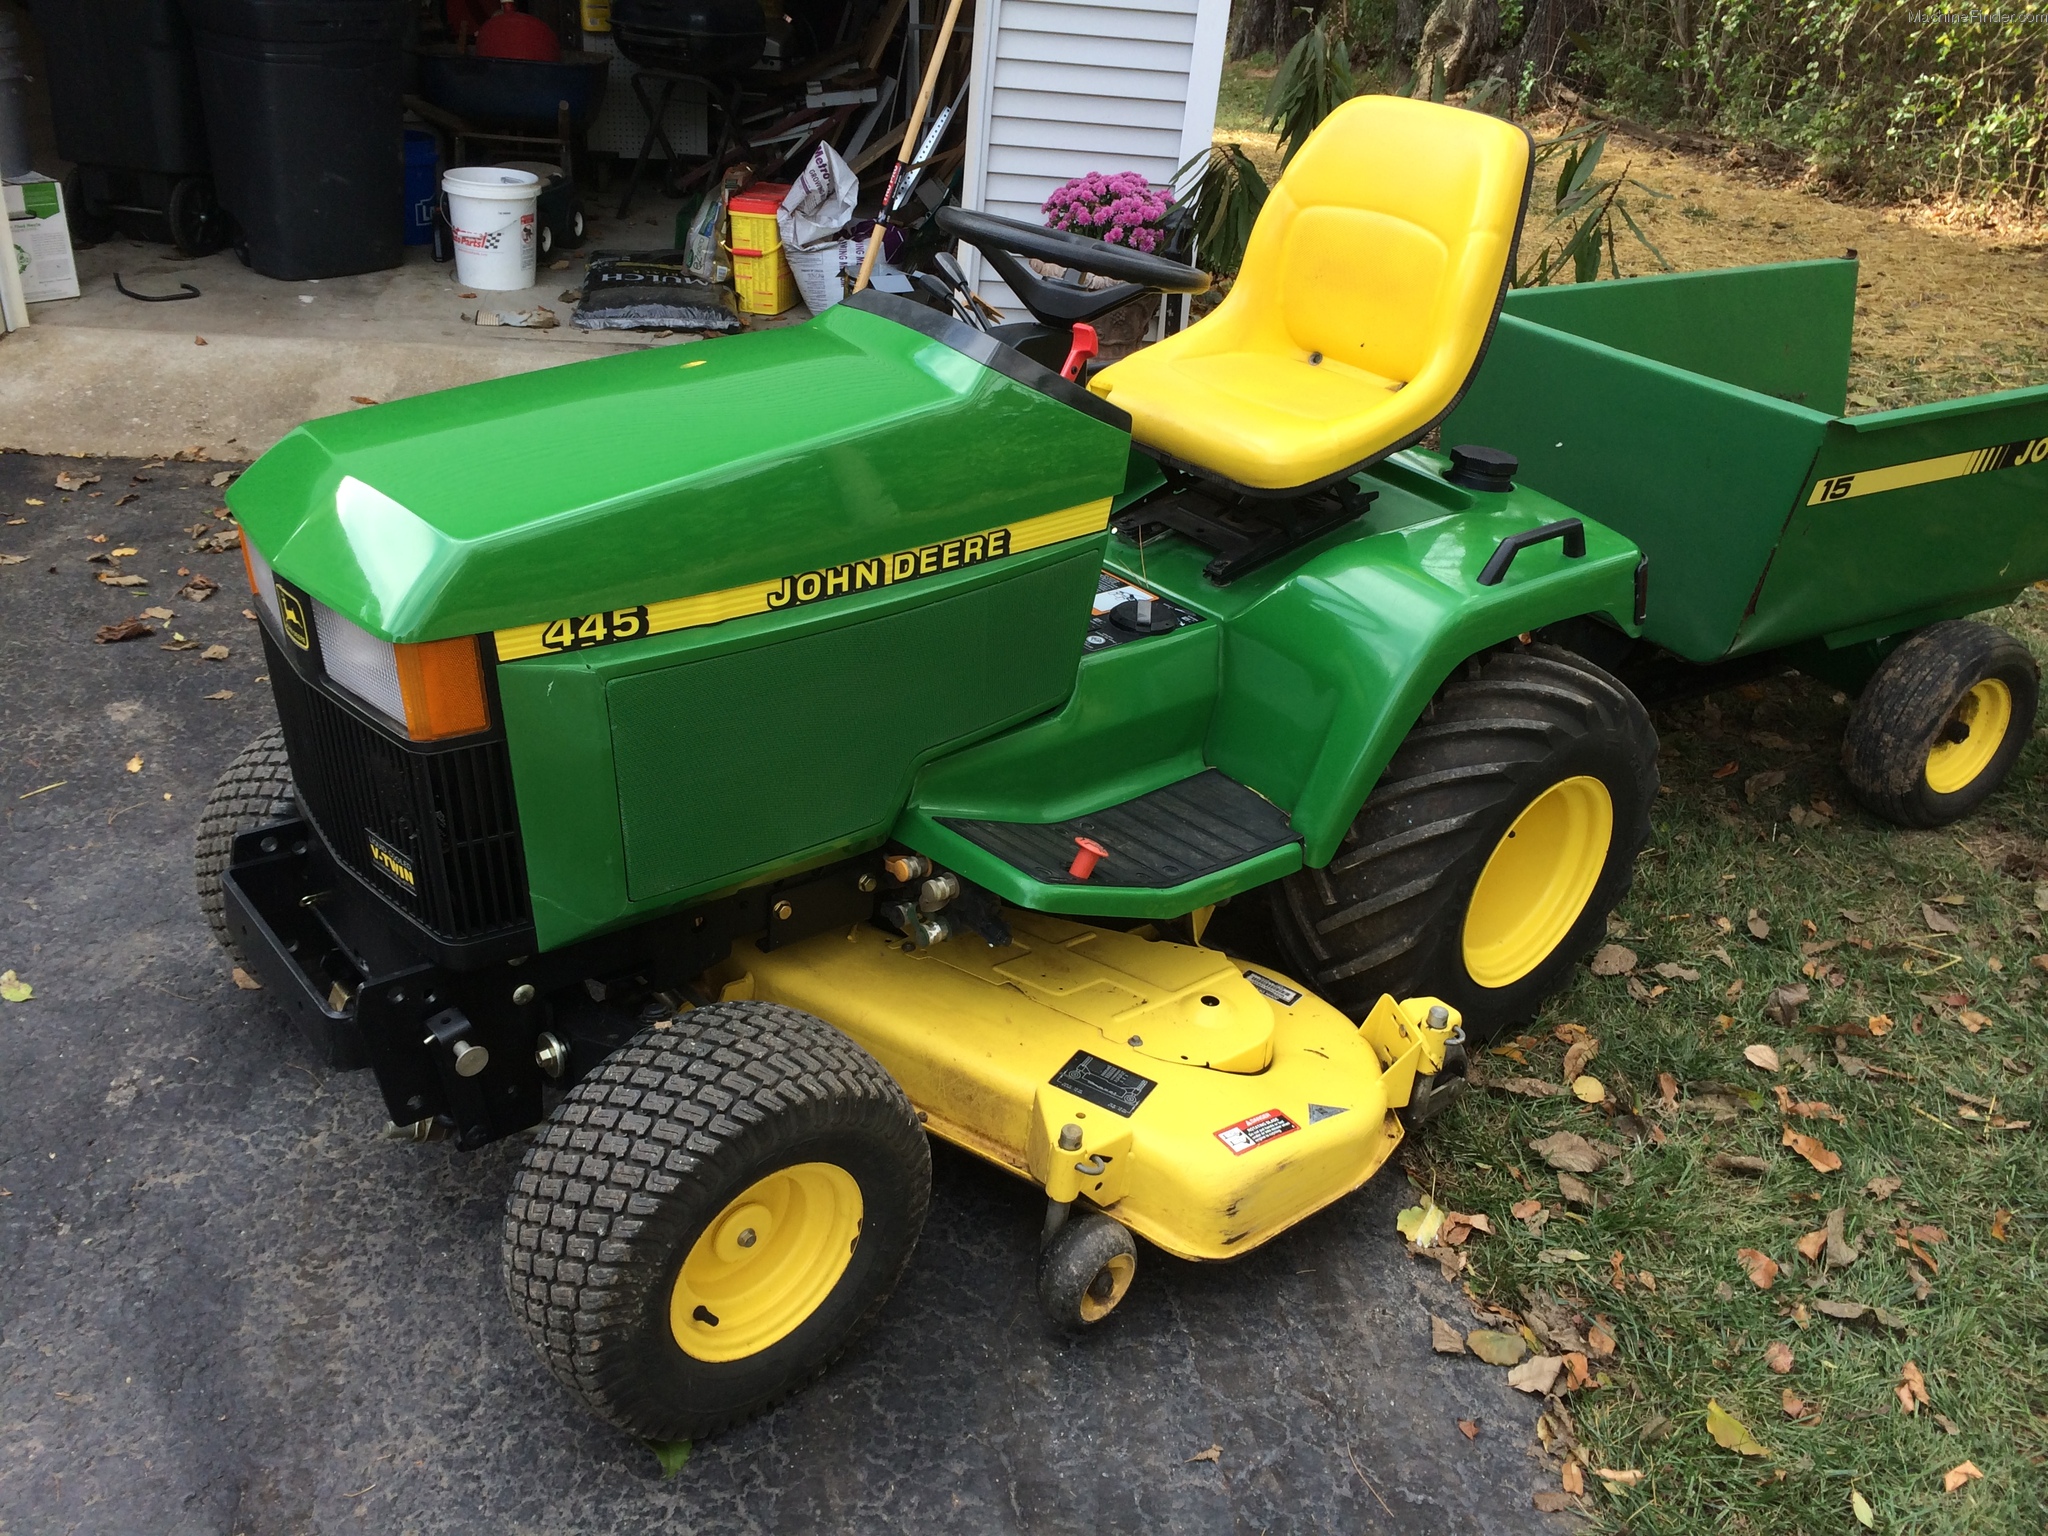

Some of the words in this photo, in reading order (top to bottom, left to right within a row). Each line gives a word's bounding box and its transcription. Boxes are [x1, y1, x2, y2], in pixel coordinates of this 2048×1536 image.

[601, 273, 709, 286] MULCH
[1820, 476, 1855, 501] 15
[768, 559, 884, 608] JOHN
[892, 529, 1011, 582] DEERE
[542, 606, 647, 648] 445
[370, 843, 414, 885] V-TWIN
